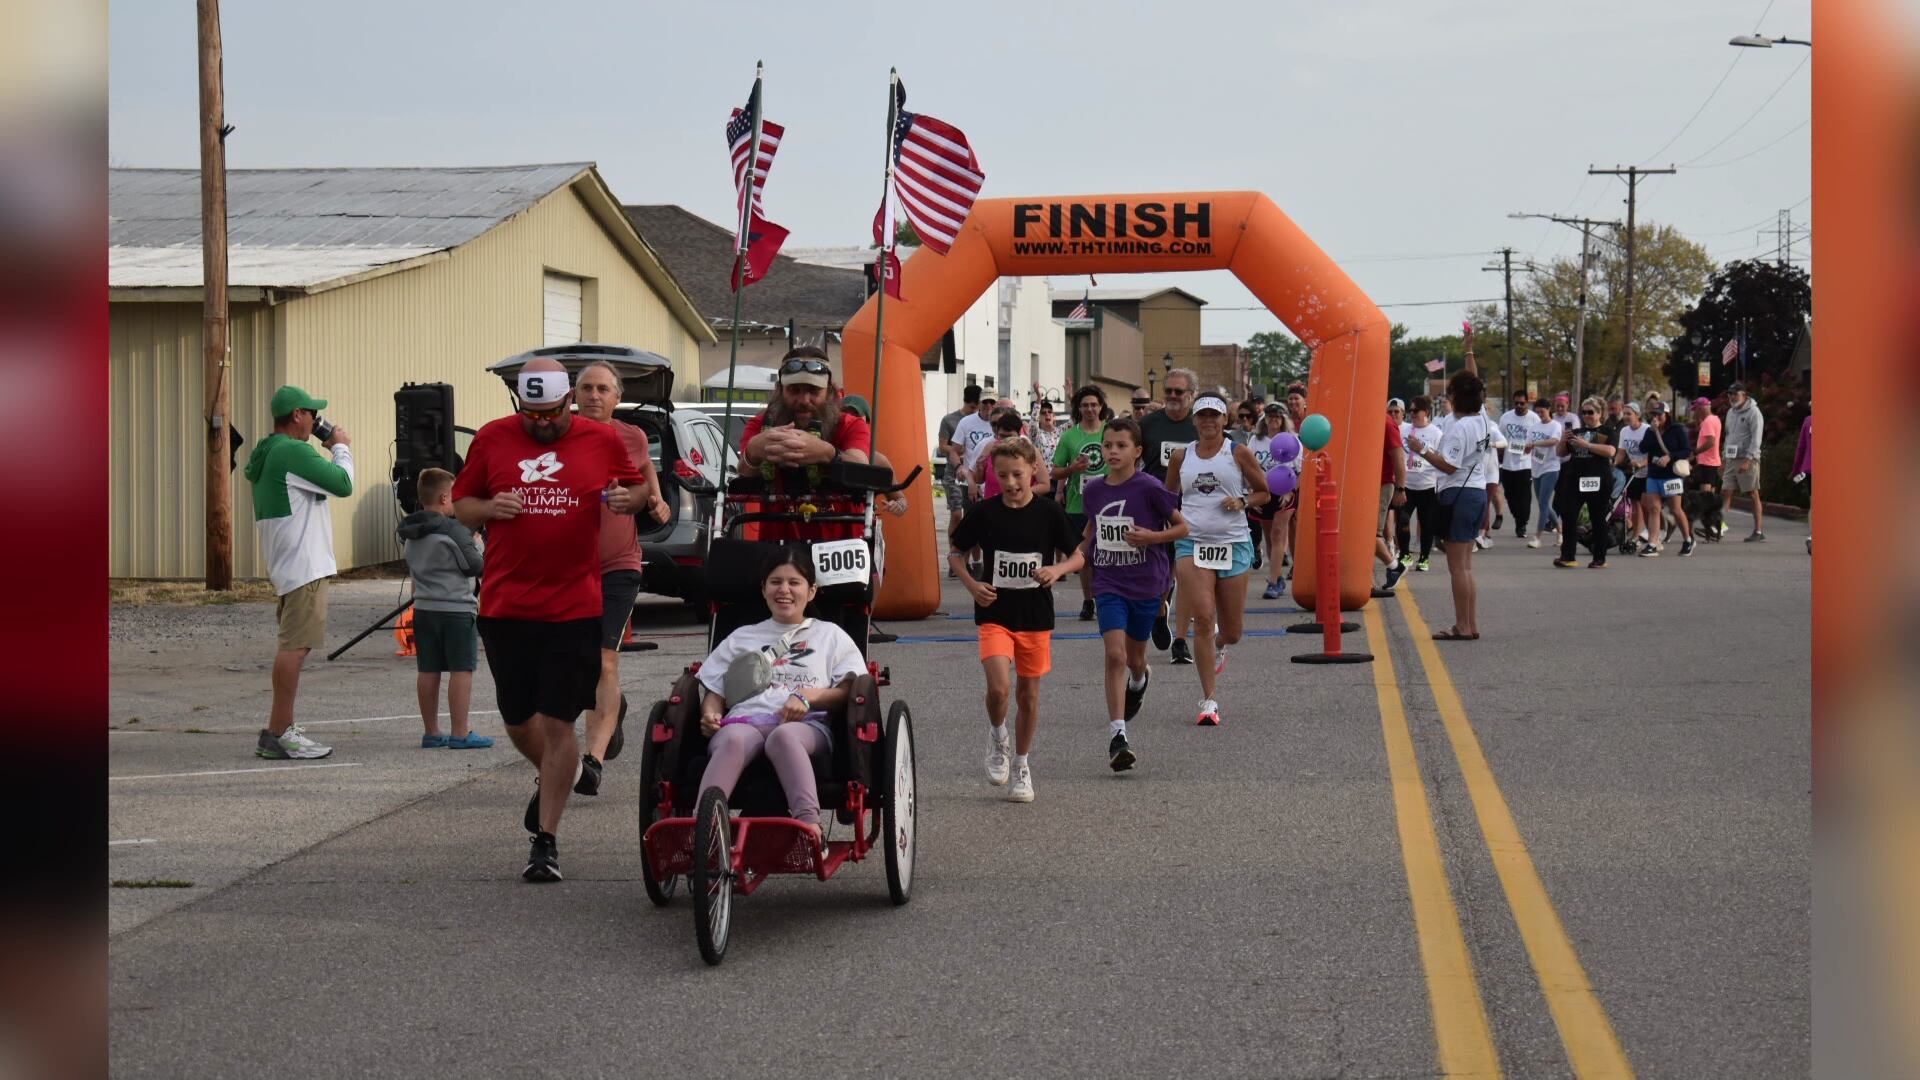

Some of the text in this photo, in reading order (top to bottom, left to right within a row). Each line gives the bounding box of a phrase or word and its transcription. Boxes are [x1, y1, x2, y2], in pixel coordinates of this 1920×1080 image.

[1014, 203, 1210, 238] FINISH
[1014, 242, 1211, 254] WWW.THTIMING.COM
[526, 377, 544, 398] S
[523, 495, 579, 507] IUMPH
[543, 507, 567, 516] Angels
[819, 549, 865, 573] 5005
[1199, 546, 1227, 560] 5072
[998, 560, 1037, 578] 5008
